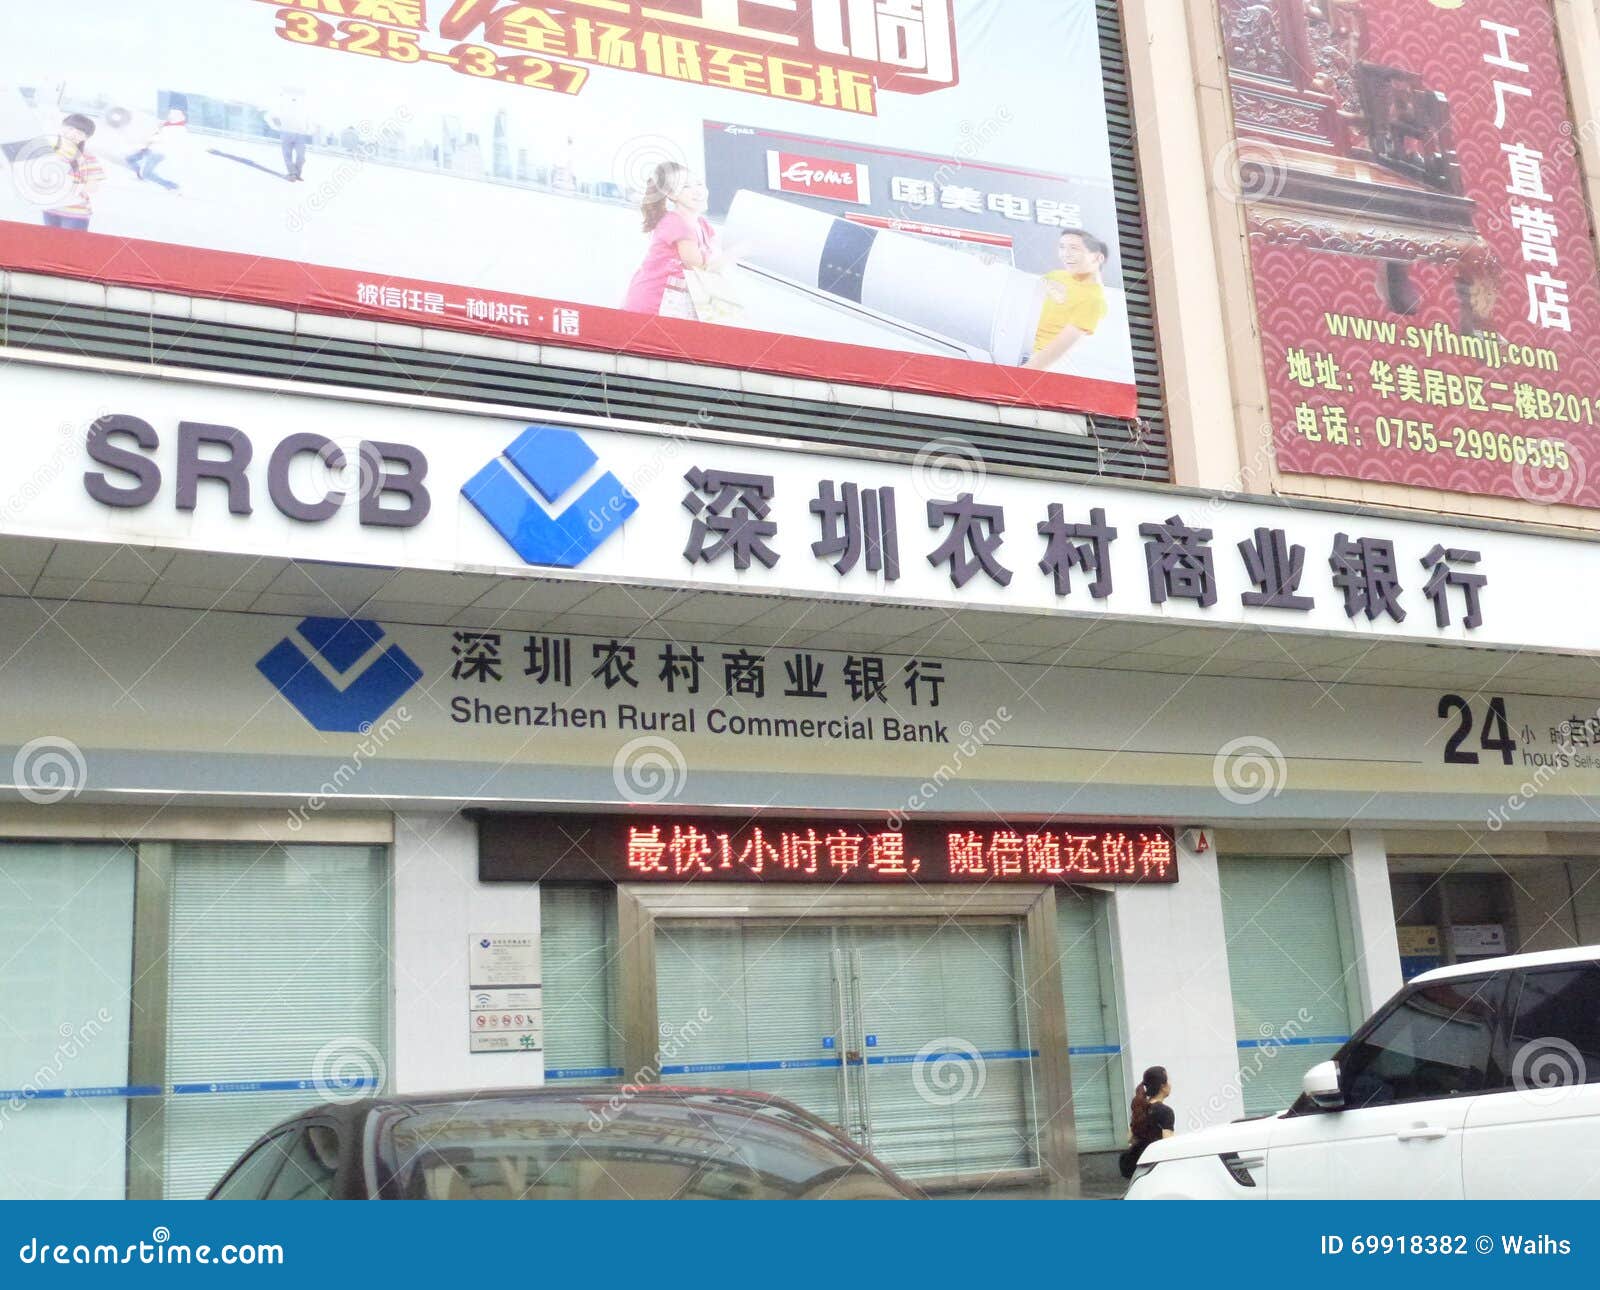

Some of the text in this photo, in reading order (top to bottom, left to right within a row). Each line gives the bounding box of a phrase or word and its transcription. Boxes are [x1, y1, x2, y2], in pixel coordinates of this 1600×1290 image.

[502, 6, 875, 113] 全场低至6折
[891, 176, 1083, 229] 国美电器
[1480, 19, 1572, 332] 工厂直营店
[356, 282, 529, 326] 被信任是一种快乐
[1324, 312, 1560, 371] www.syfhmjj.com
[1287, 347, 1600, 425] 地址：华美居B区二楼B201
[83, 414, 431, 528] SRCB
[682, 465, 1488, 629] 深圳农村商业银行
[451, 631, 945, 707] 深圳农村商业银行
[451, 695, 949, 743] Shenzhen Rural Commercial Bank
[1438, 694, 1517, 765] 24
[1522, 748, 1569, 768] hours
